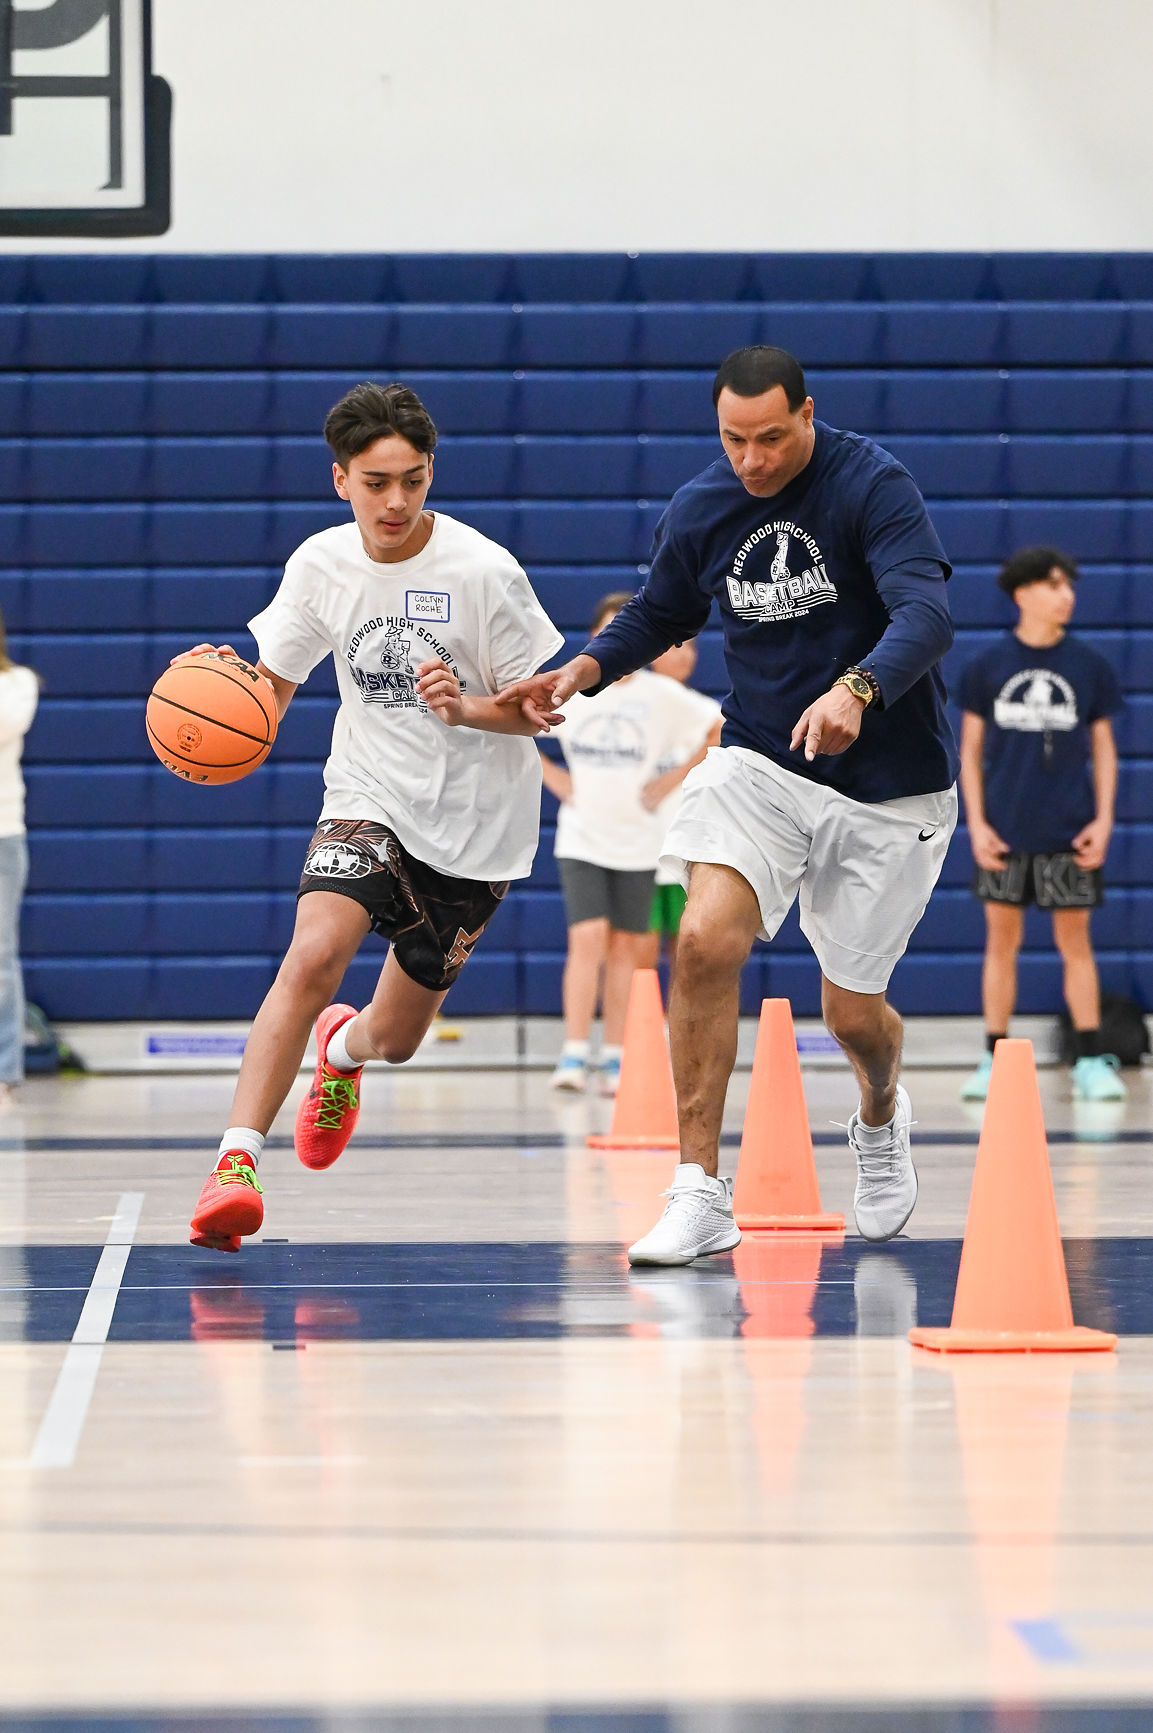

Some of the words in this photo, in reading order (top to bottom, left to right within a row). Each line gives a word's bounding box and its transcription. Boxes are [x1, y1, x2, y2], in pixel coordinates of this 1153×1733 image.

[733, 523, 773, 576] REDWOOD
[792, 523, 823, 565] CHOOL
[415, 603, 443, 614] ROCHE
[726, 563, 838, 609] BASETBALL
[347, 617, 384, 661] REDWOOD
[386, 616, 414, 630] HIGH
[416, 627, 454, 667] SCHOOL
